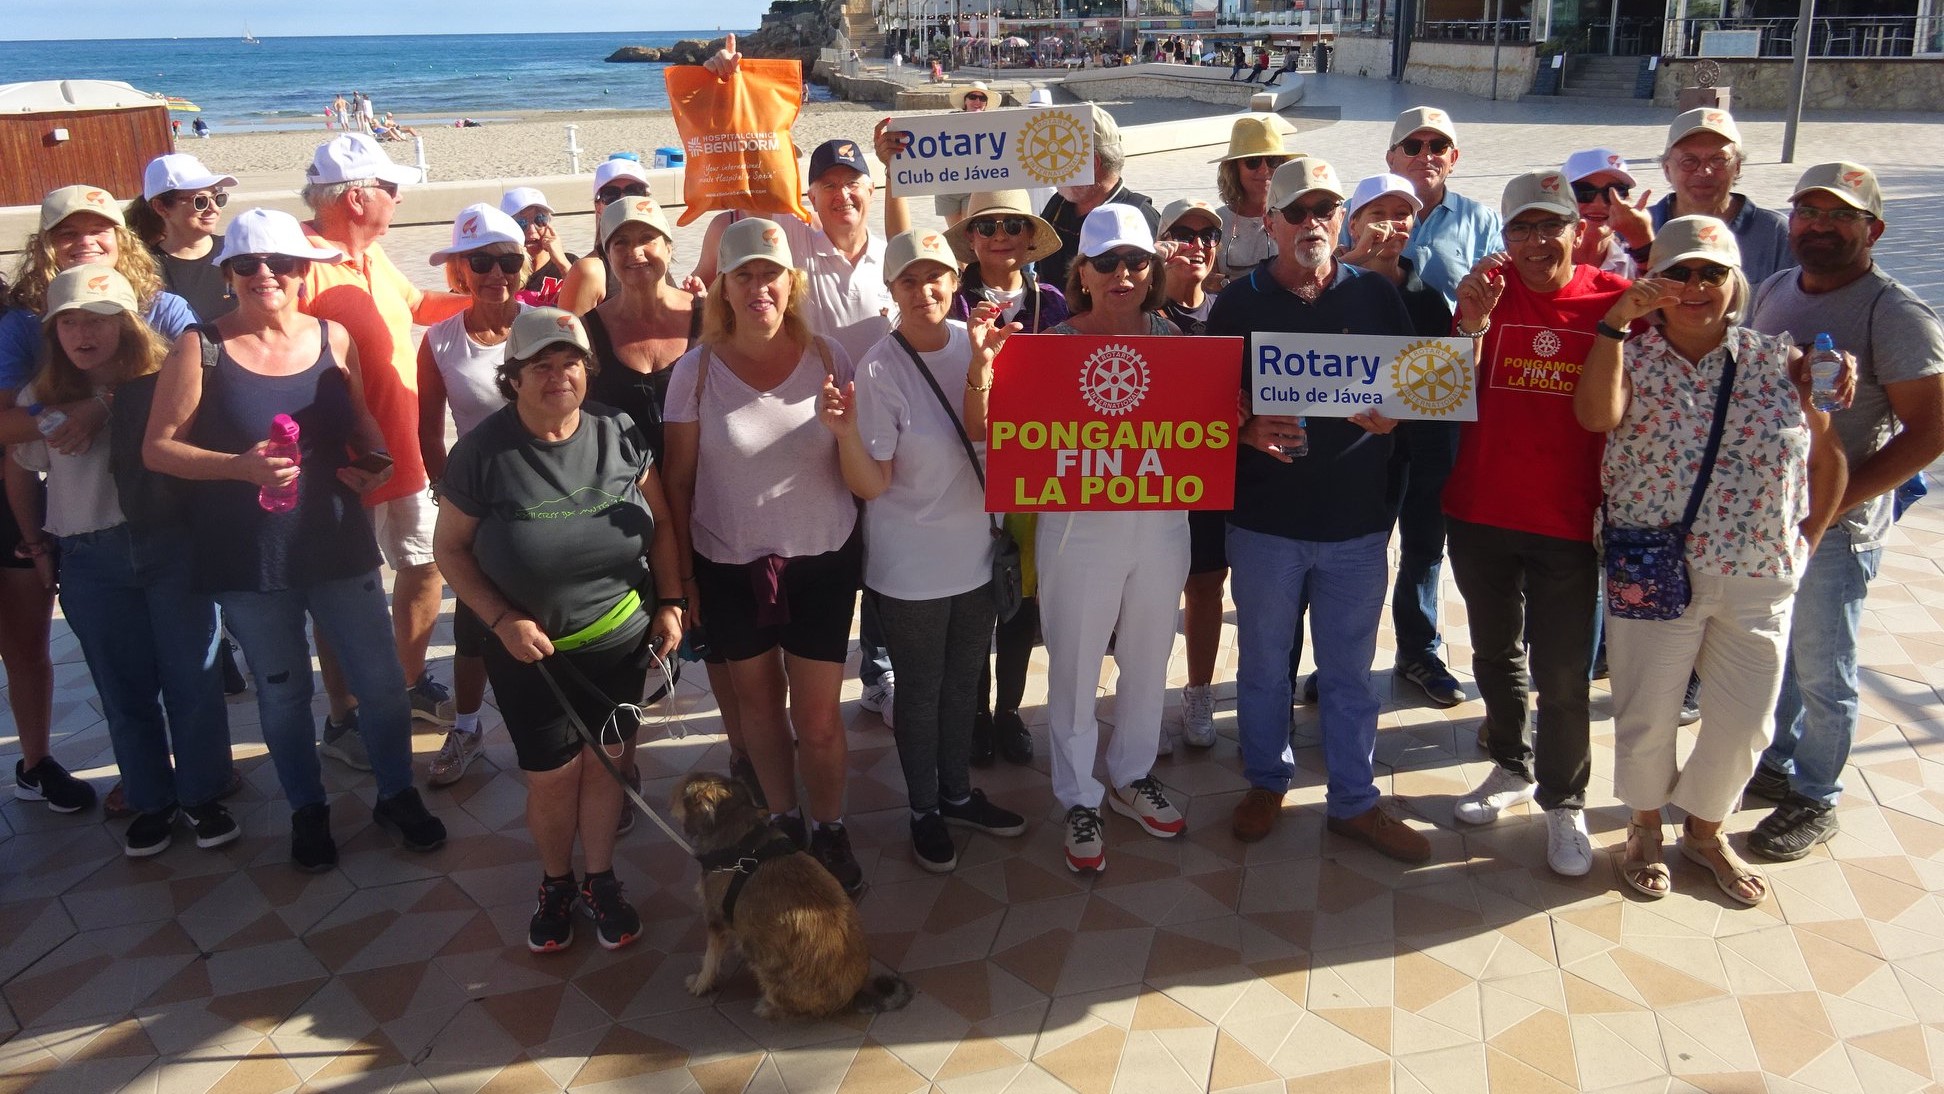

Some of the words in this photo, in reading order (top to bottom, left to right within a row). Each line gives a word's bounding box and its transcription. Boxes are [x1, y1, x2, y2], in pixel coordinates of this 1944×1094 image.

[703, 139, 780, 154] BENIDORM
[895, 129, 1007, 161] Rotary
[897, 169, 934, 185] Club
[939, 168, 960, 183] de
[963, 165, 1009, 181] Jávea
[1101, 350, 1132, 360] ROTARY
[1258, 345, 1381, 385] Rotary
[1503, 357, 1584, 375] PONGAMOS
[1523, 367, 1547, 379] FIN
[1550, 370, 1561, 381] A
[1507, 376, 1525, 387] LA
[1529, 378, 1574, 392] POLIO
[1089, 389, 1140, 410] INTERNATIONAL
[1260, 386, 1300, 402] Club
[1305, 387, 1328, 403] de
[1333, 388, 1383, 405] Jávea
[992, 420, 1230, 449] PONGAMOS
[1056, 448, 1123, 477] FIN
[1136, 448, 1165, 477] A
[1015, 476, 1067, 505] LA
[1080, 475, 1204, 504] POLIO
